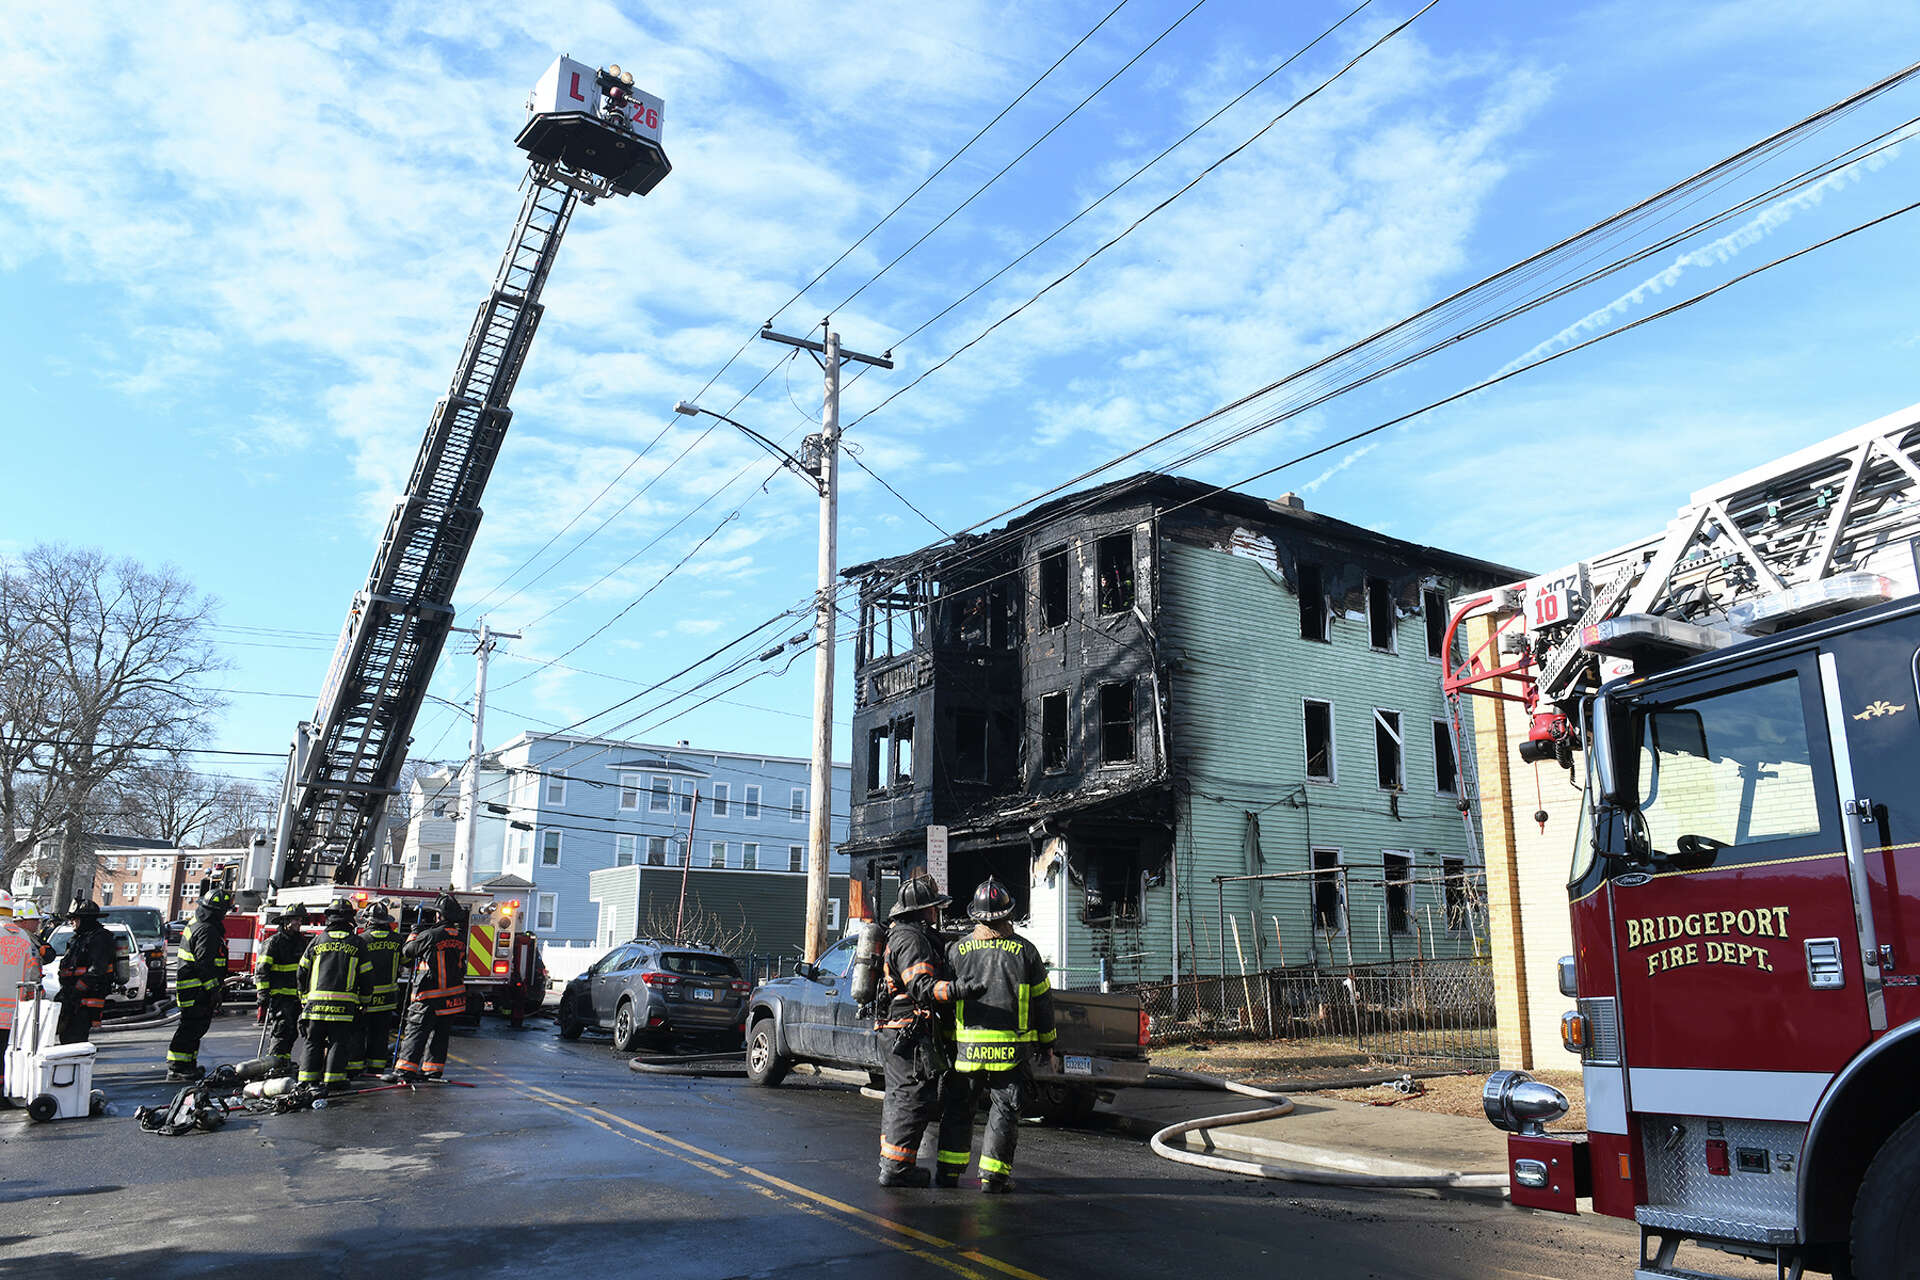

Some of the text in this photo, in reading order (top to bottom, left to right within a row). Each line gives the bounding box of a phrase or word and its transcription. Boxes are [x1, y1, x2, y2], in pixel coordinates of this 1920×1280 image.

[570, 72, 658, 129] L 26
[1536, 594, 1558, 625] 10
[1626, 906, 1791, 949] BRIDGEPORT
[313, 942, 359, 956] BRIDGEPORT
[958, 939, 1023, 956] BRIDGEPORT
[1647, 941, 1774, 978] FIRE DEPT.
[966, 1047, 1015, 1060] GARDNER
